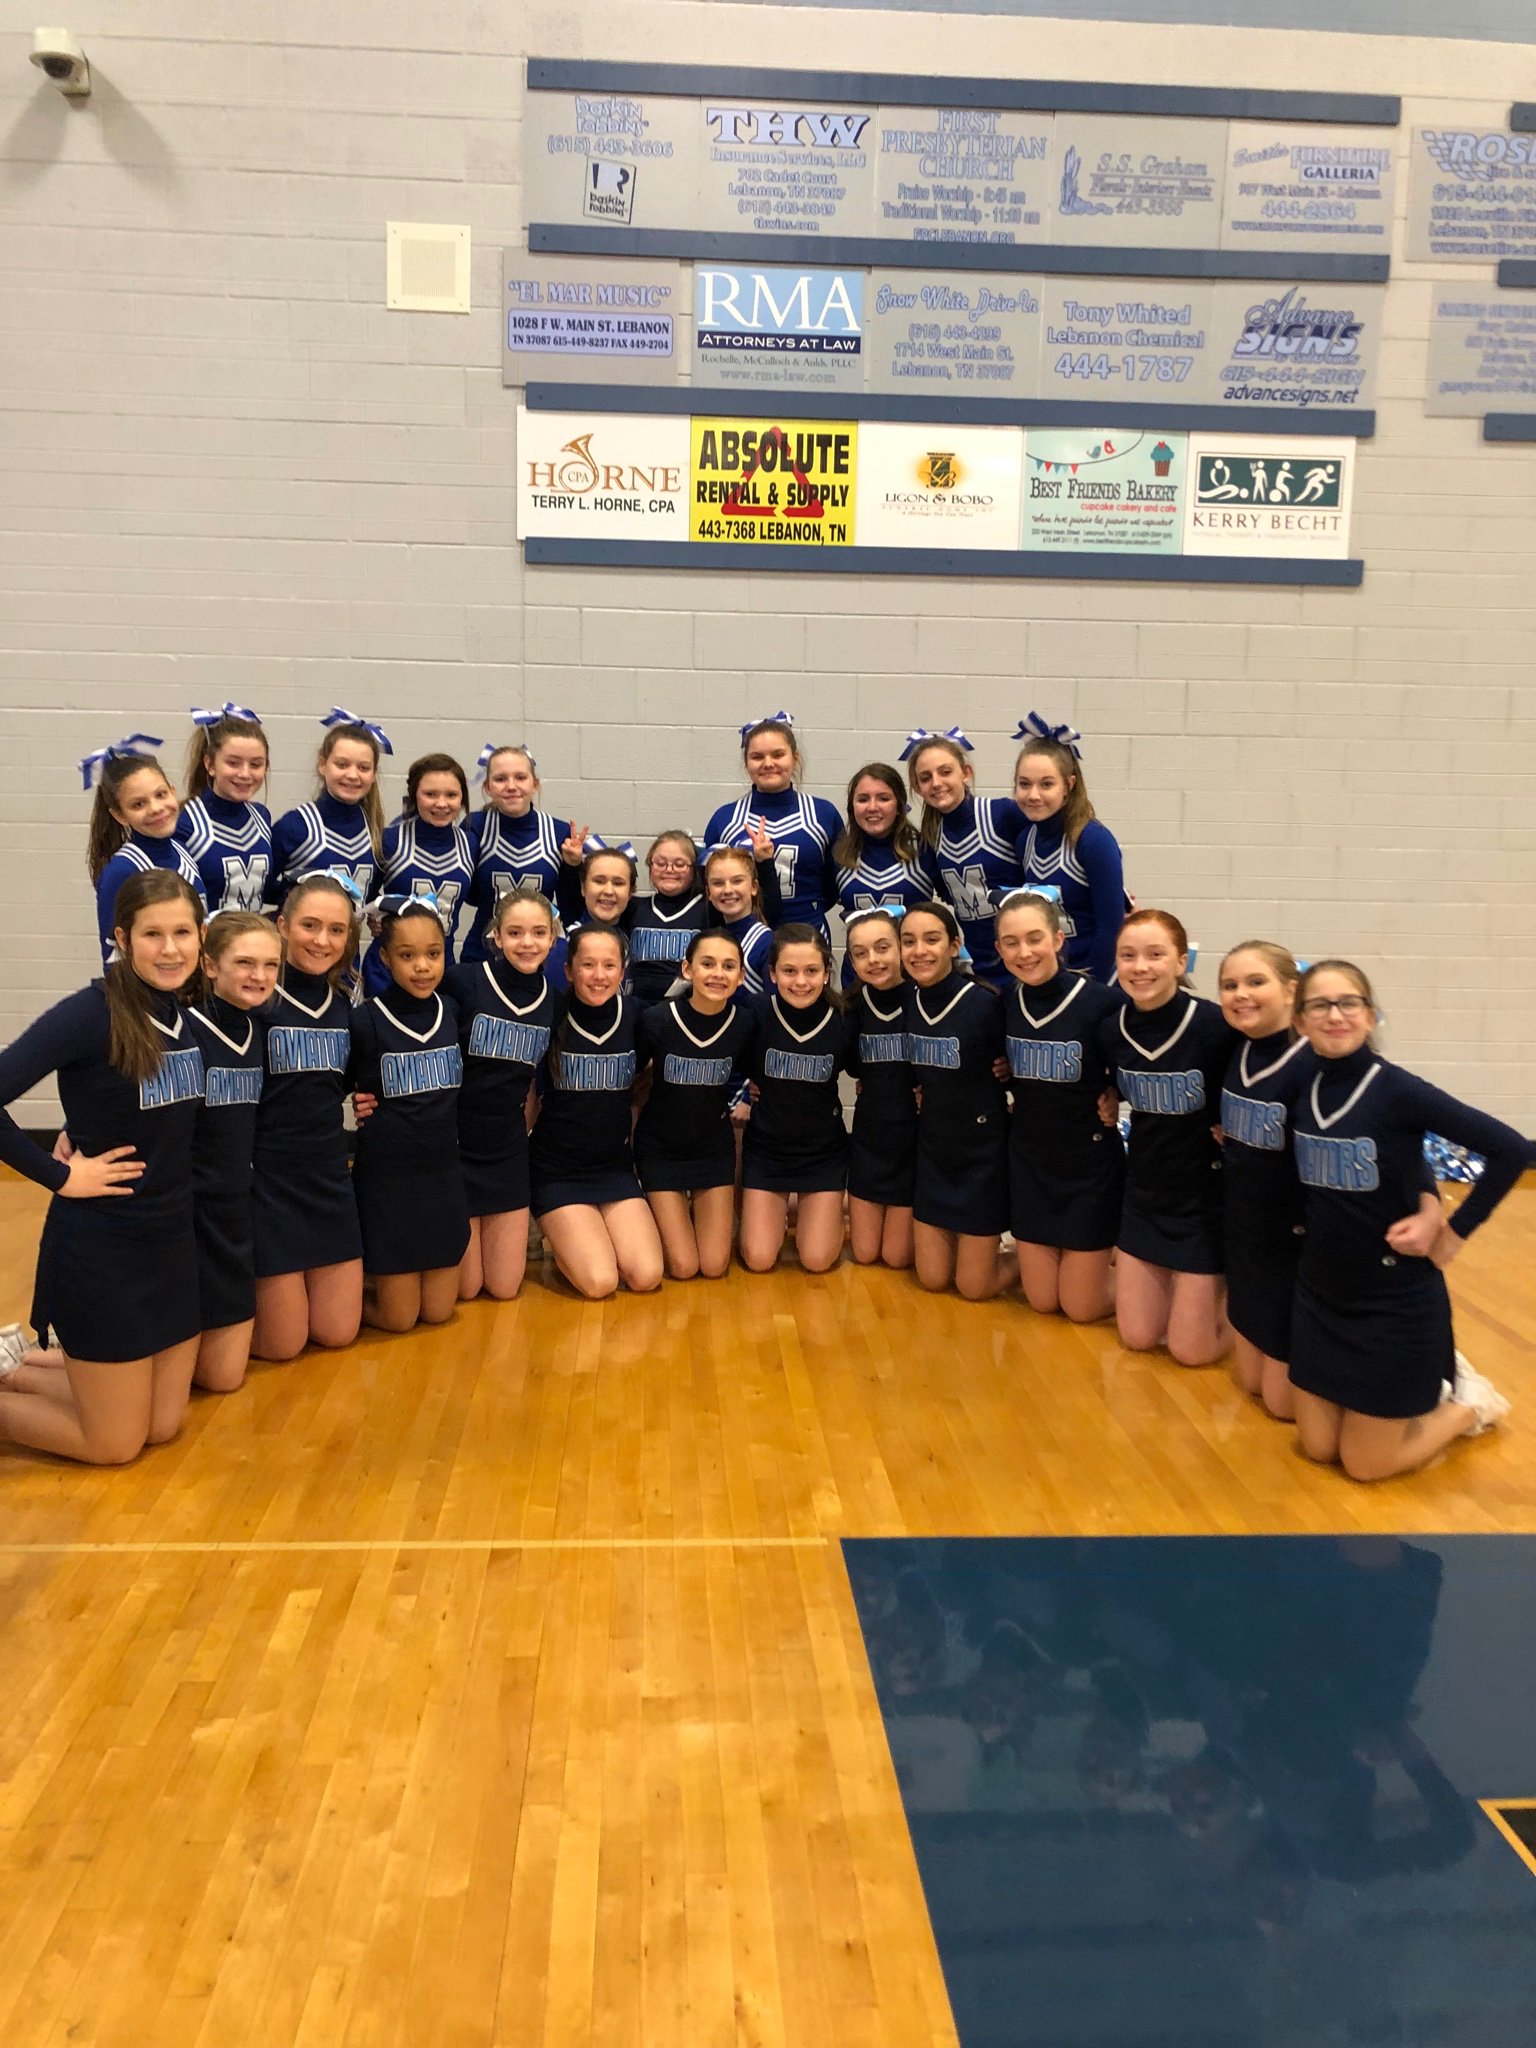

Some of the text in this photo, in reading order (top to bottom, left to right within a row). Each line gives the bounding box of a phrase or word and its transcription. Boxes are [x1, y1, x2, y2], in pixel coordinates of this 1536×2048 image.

[706, 107, 871, 149] THW
[937, 108, 1002, 134] FIRST
[881, 130, 1047, 160] PRESBYTERIAN
[919, 154, 1015, 182] CHURCH
[1303, 166, 1375, 180] GALLERIA
[590, 192, 625, 207] baskin
[787, 186, 806, 198] TN
[547, 282, 593, 304] MAR
[697, 272, 862, 331] RMA
[876, 284, 1039, 322] Snow White Drive-In
[1063, 301, 1191, 327] Tony Whited
[1245, 286, 1355, 326] Advance
[512, 316, 670, 335] 1028 F W. MAIN ST. LEBANON
[1047, 326, 1205, 349] Lebanon Chemical
[512, 334, 669, 350] TN 37087 615-449-8237 FAX 449-2704
[701, 333, 856, 350] ATTORNEYS AT LAW
[1233, 322, 1365, 356] SIGNS
[927, 344, 960, 360] West
[962, 345, 993, 360] Main
[719, 368, 837, 384] www.rma-law.com
[892, 361, 952, 380] Lebanon,
[955, 364, 974, 379] TN
[1055, 352, 1194, 383] 444-1787
[1224, 384, 1360, 406] advancesigns.net
[698, 430, 850, 474] ABSOLUTE
[567, 471, 590, 484] CPA
[1030, 477, 1178, 502] BEST FRIENDS BAKERY
[531, 494, 676, 515] TERRY L. HORNE, CPA
[697, 480, 849, 507] RENTAL & SUPPLY
[885, 493, 994, 506] LIGON & BOBO
[1080, 502, 1177, 513] cupcake cakery and cafe
[698, 519, 846, 546] 443-7368 LEBANON, TN
[1192, 512, 1262, 529] KERRY
[1271, 514, 1343, 531] BECHT
[219, 853, 269, 912] M
[941, 863, 1004, 921] M
[663, 1053, 733, 1086] AVIATORS
[764, 1048, 835, 1083] AVIATORS
